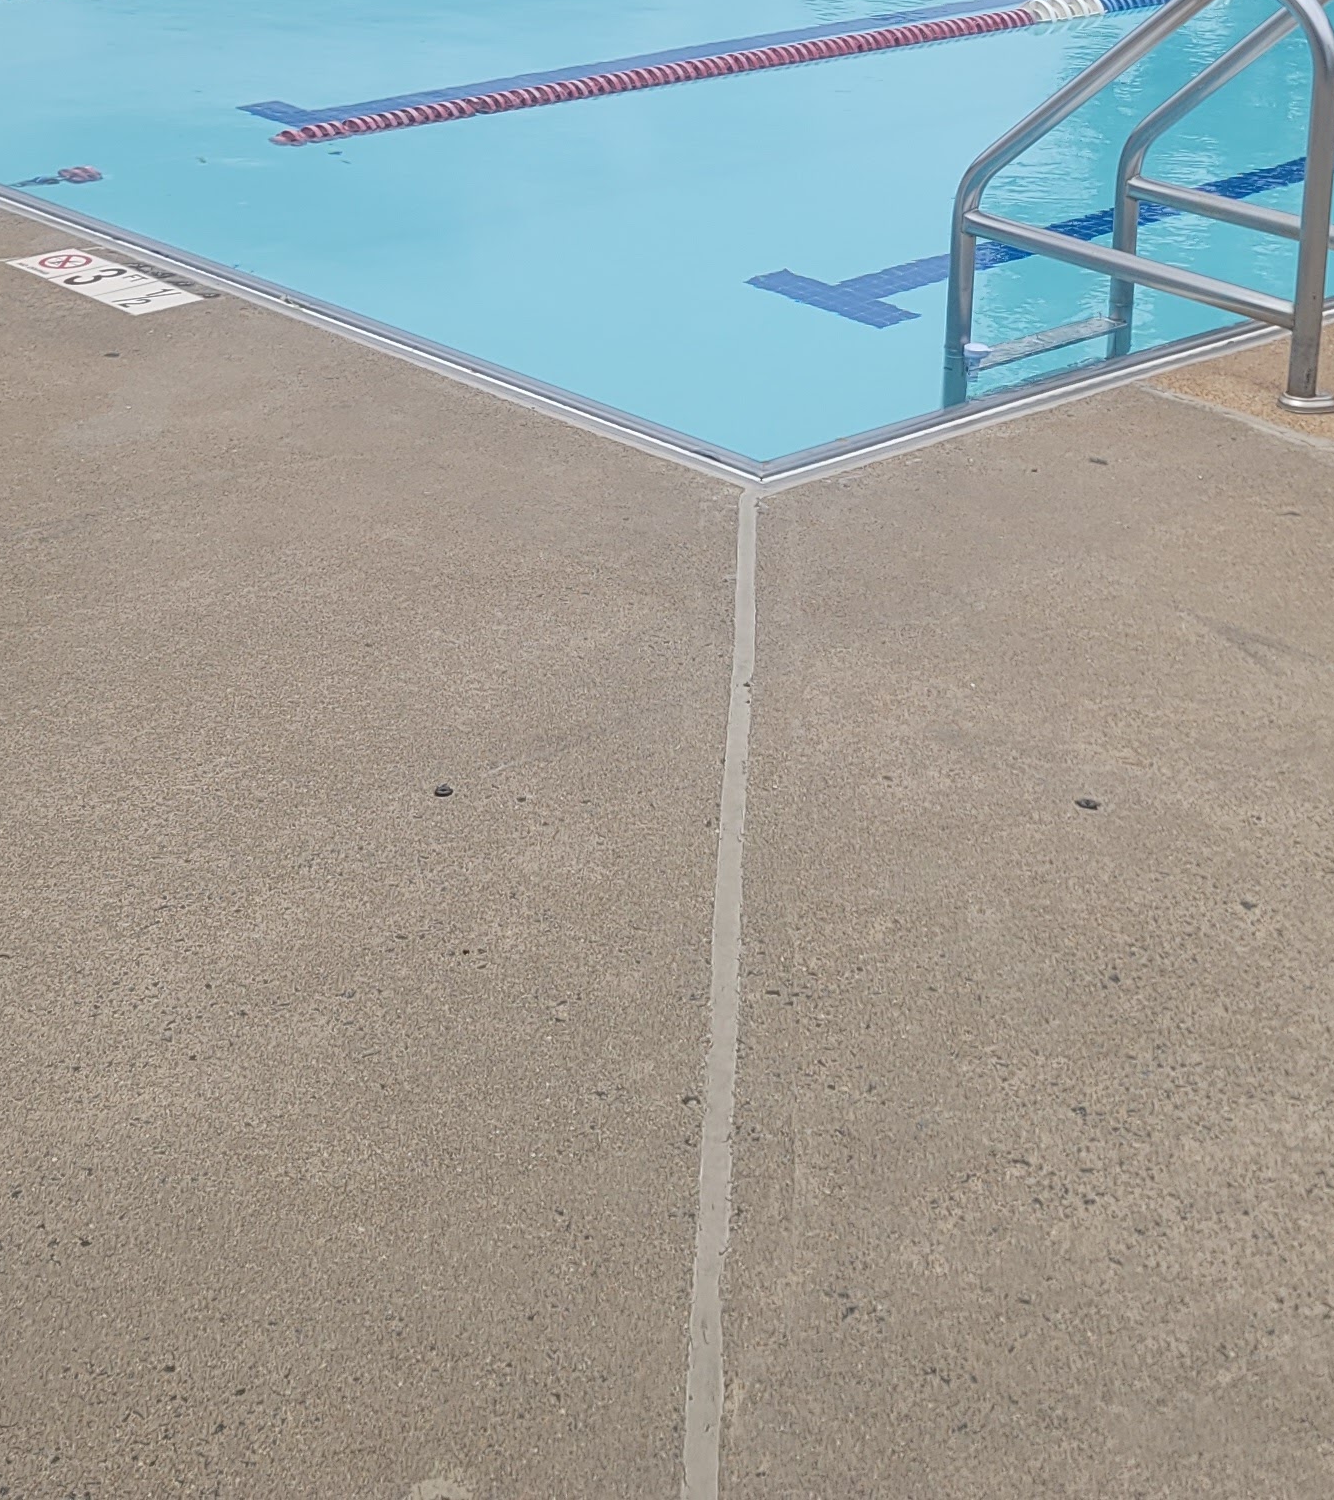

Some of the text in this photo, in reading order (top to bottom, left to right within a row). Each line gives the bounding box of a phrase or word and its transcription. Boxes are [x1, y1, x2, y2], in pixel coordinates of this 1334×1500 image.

[64, 267, 127, 285] 3
[121, 274, 149, 283] FT
[111, 288, 182, 308] 1/2
